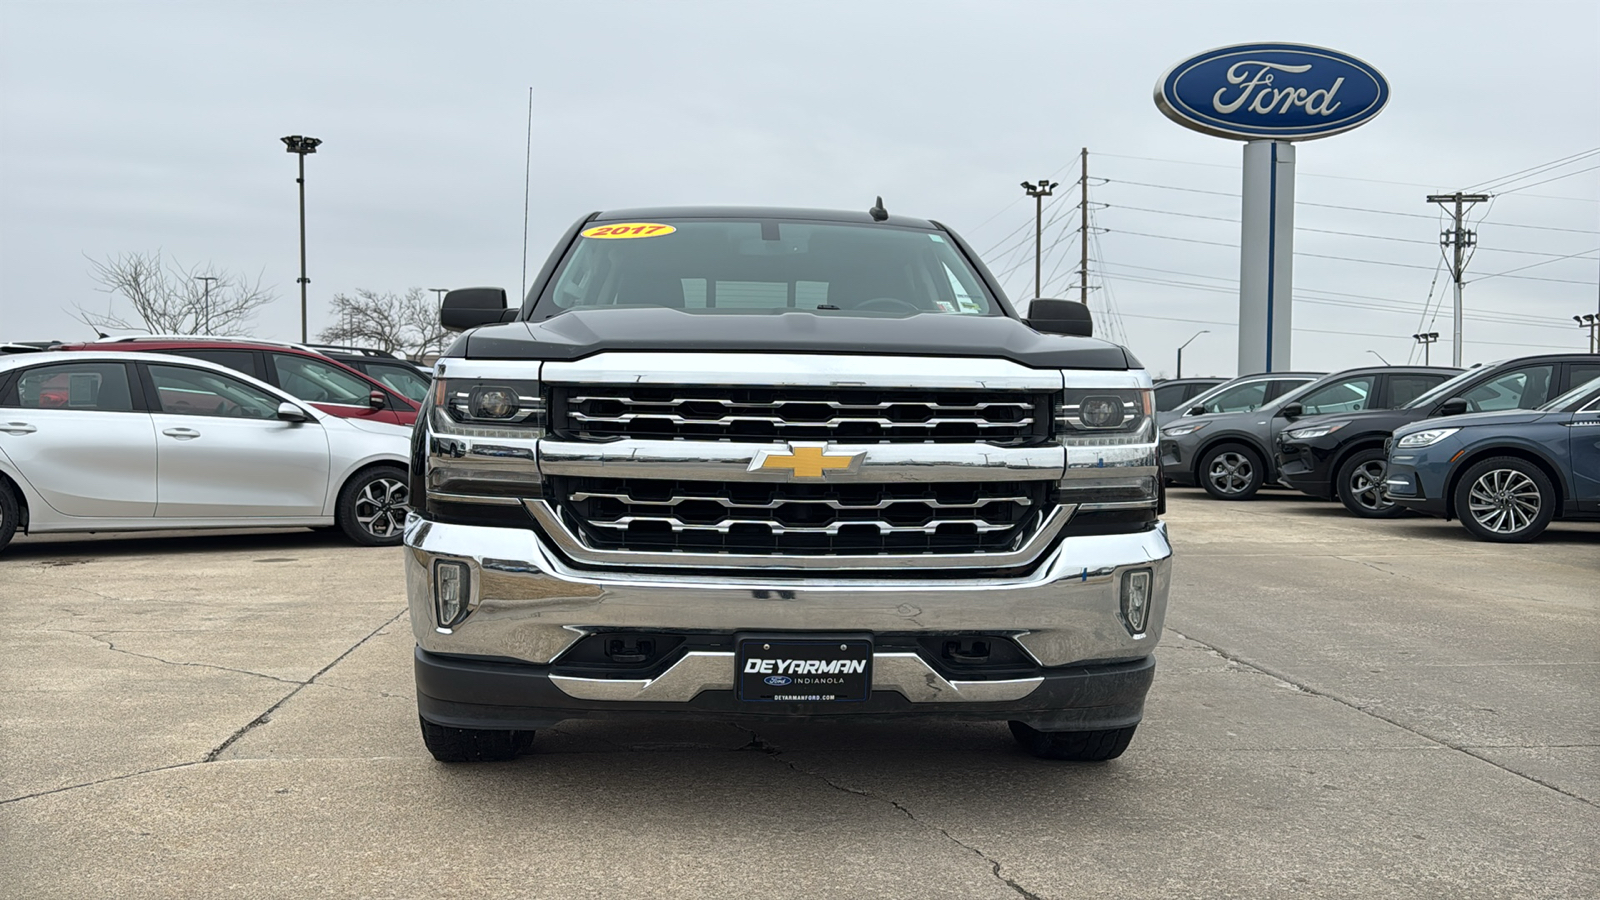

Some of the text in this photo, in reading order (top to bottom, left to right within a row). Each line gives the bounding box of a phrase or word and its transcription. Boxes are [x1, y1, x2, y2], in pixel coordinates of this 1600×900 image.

[1212, 60, 1345, 116] Ford
[590, 225, 666, 236] 2017
[744, 658, 867, 674] DEYARMAN
